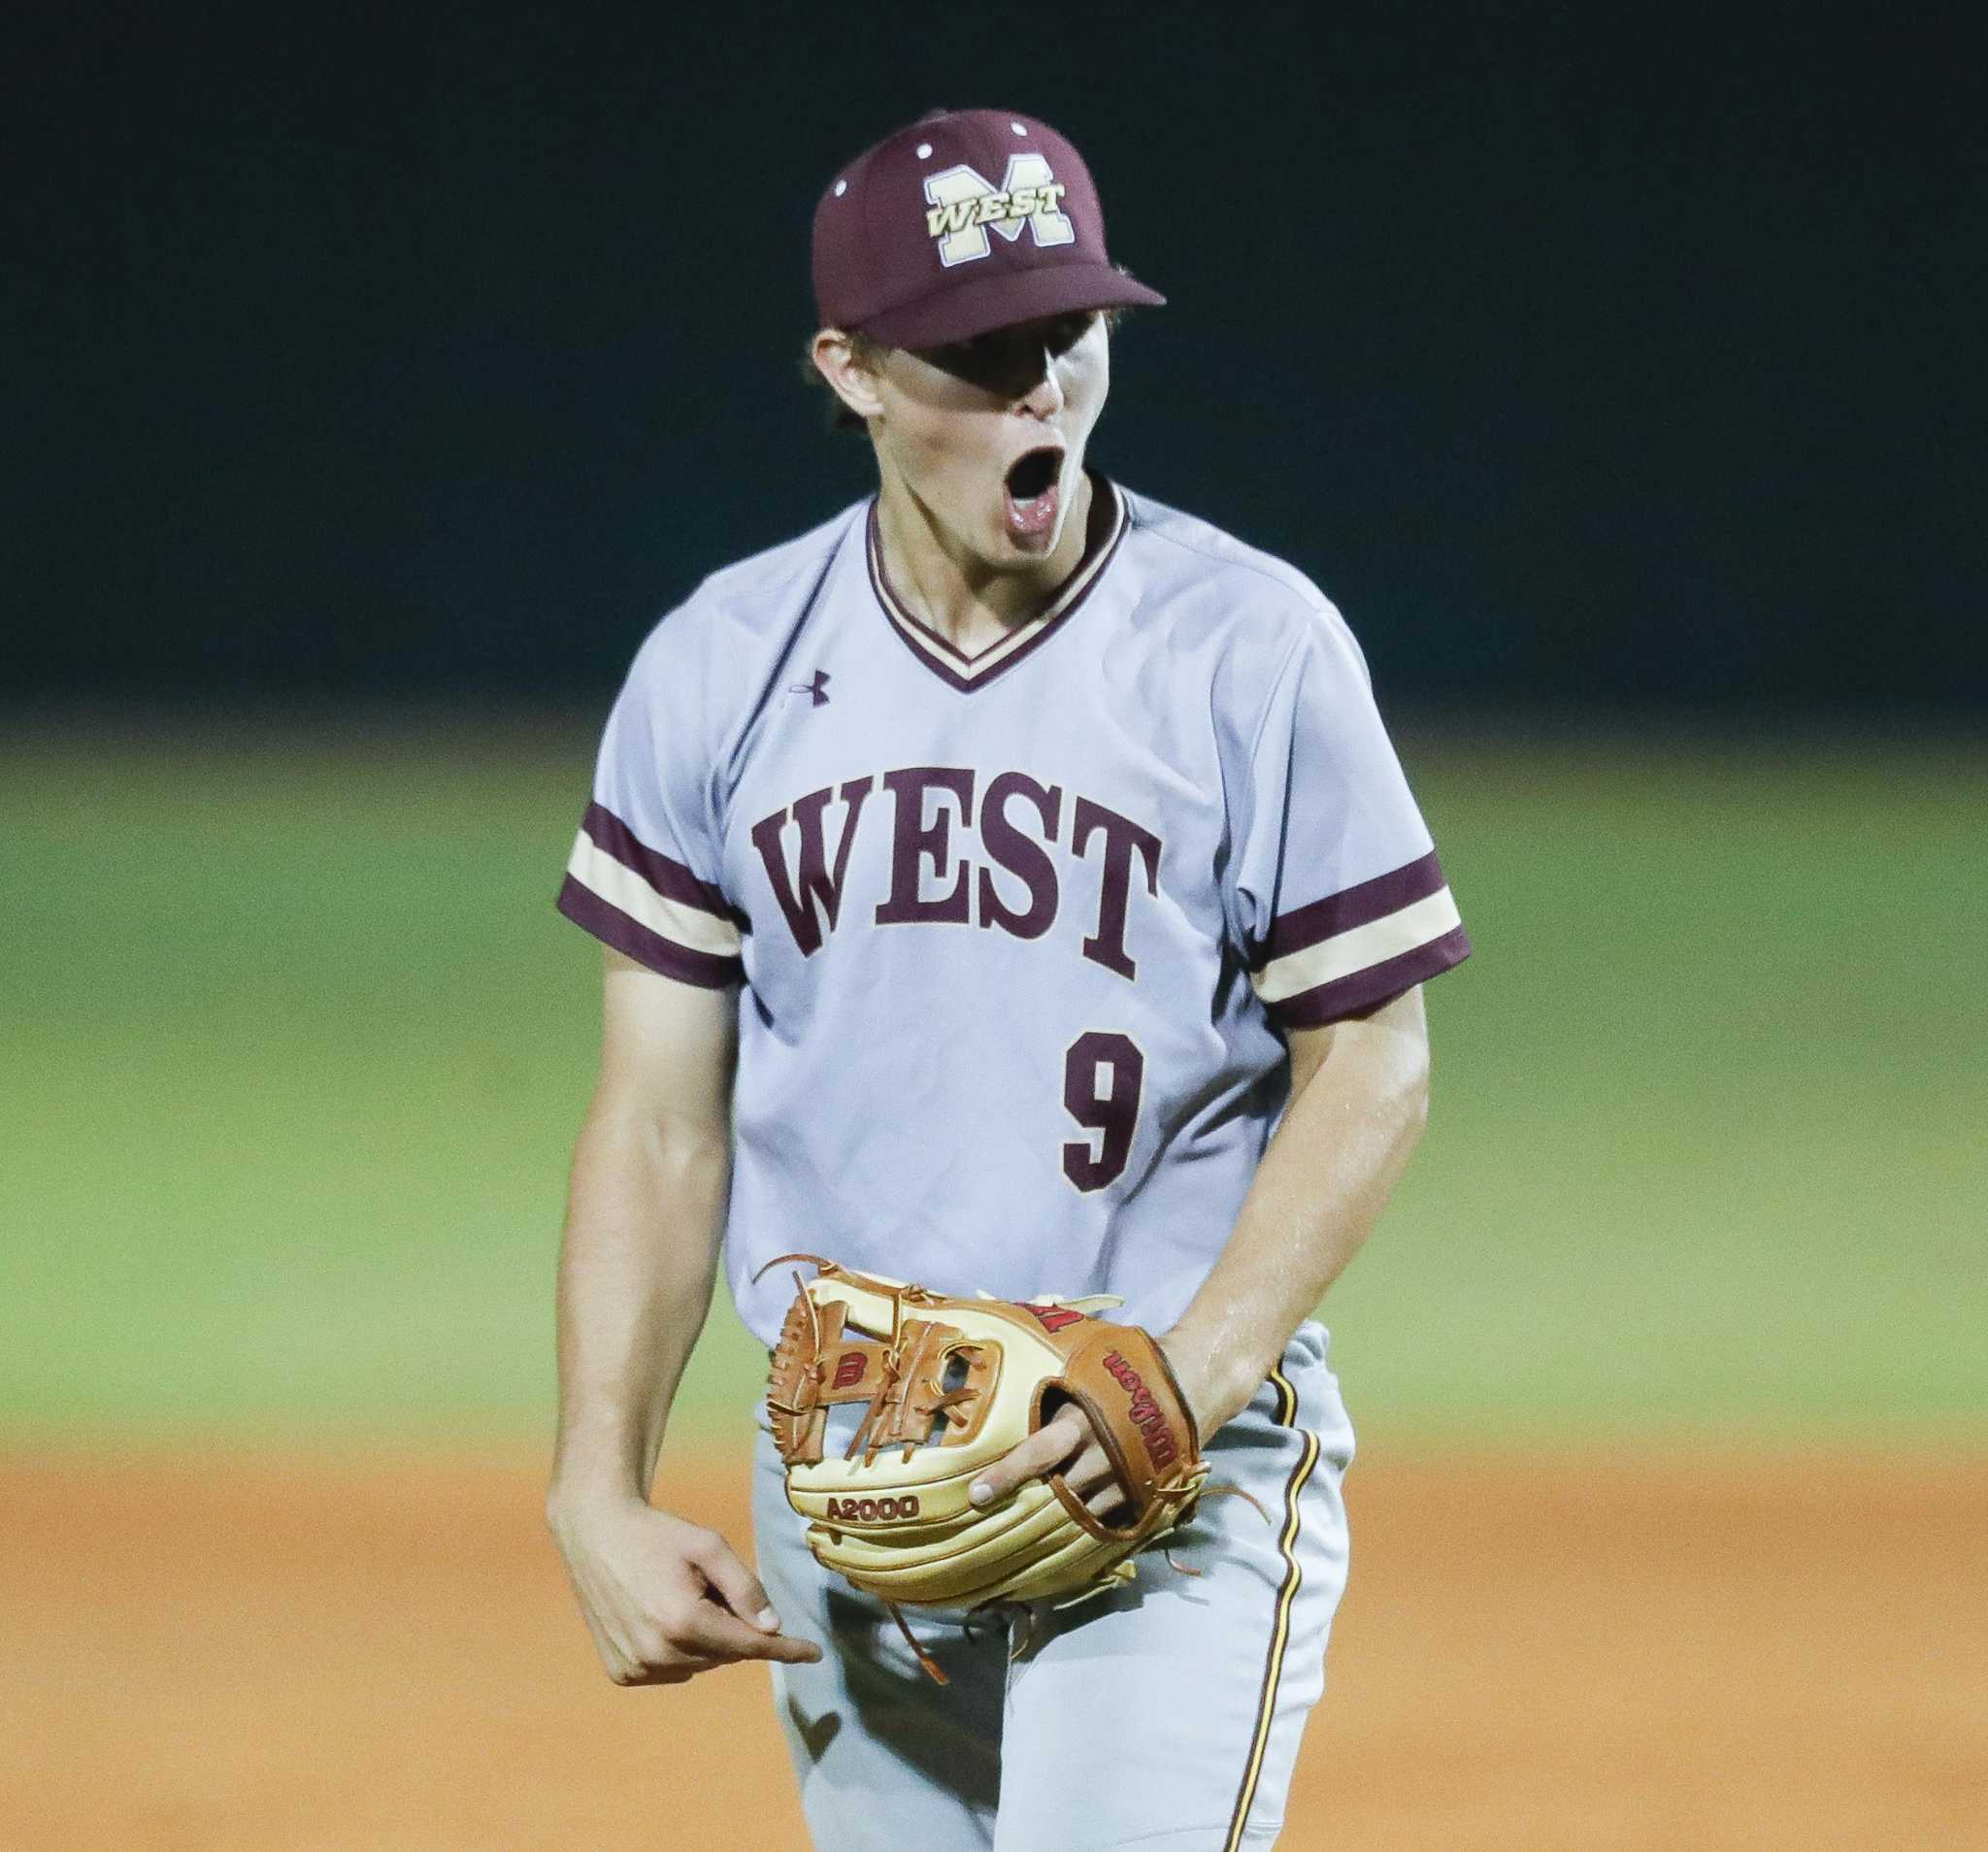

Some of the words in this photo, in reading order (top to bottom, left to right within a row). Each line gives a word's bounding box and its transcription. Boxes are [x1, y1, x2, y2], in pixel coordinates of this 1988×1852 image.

[924, 153, 1075, 268] M
[925, 184, 1065, 237] WEST
[750, 766, 1163, 983] WEST
[1062, 1030, 1144, 1193] 9
[826, 1495, 920, 1522] A2000
